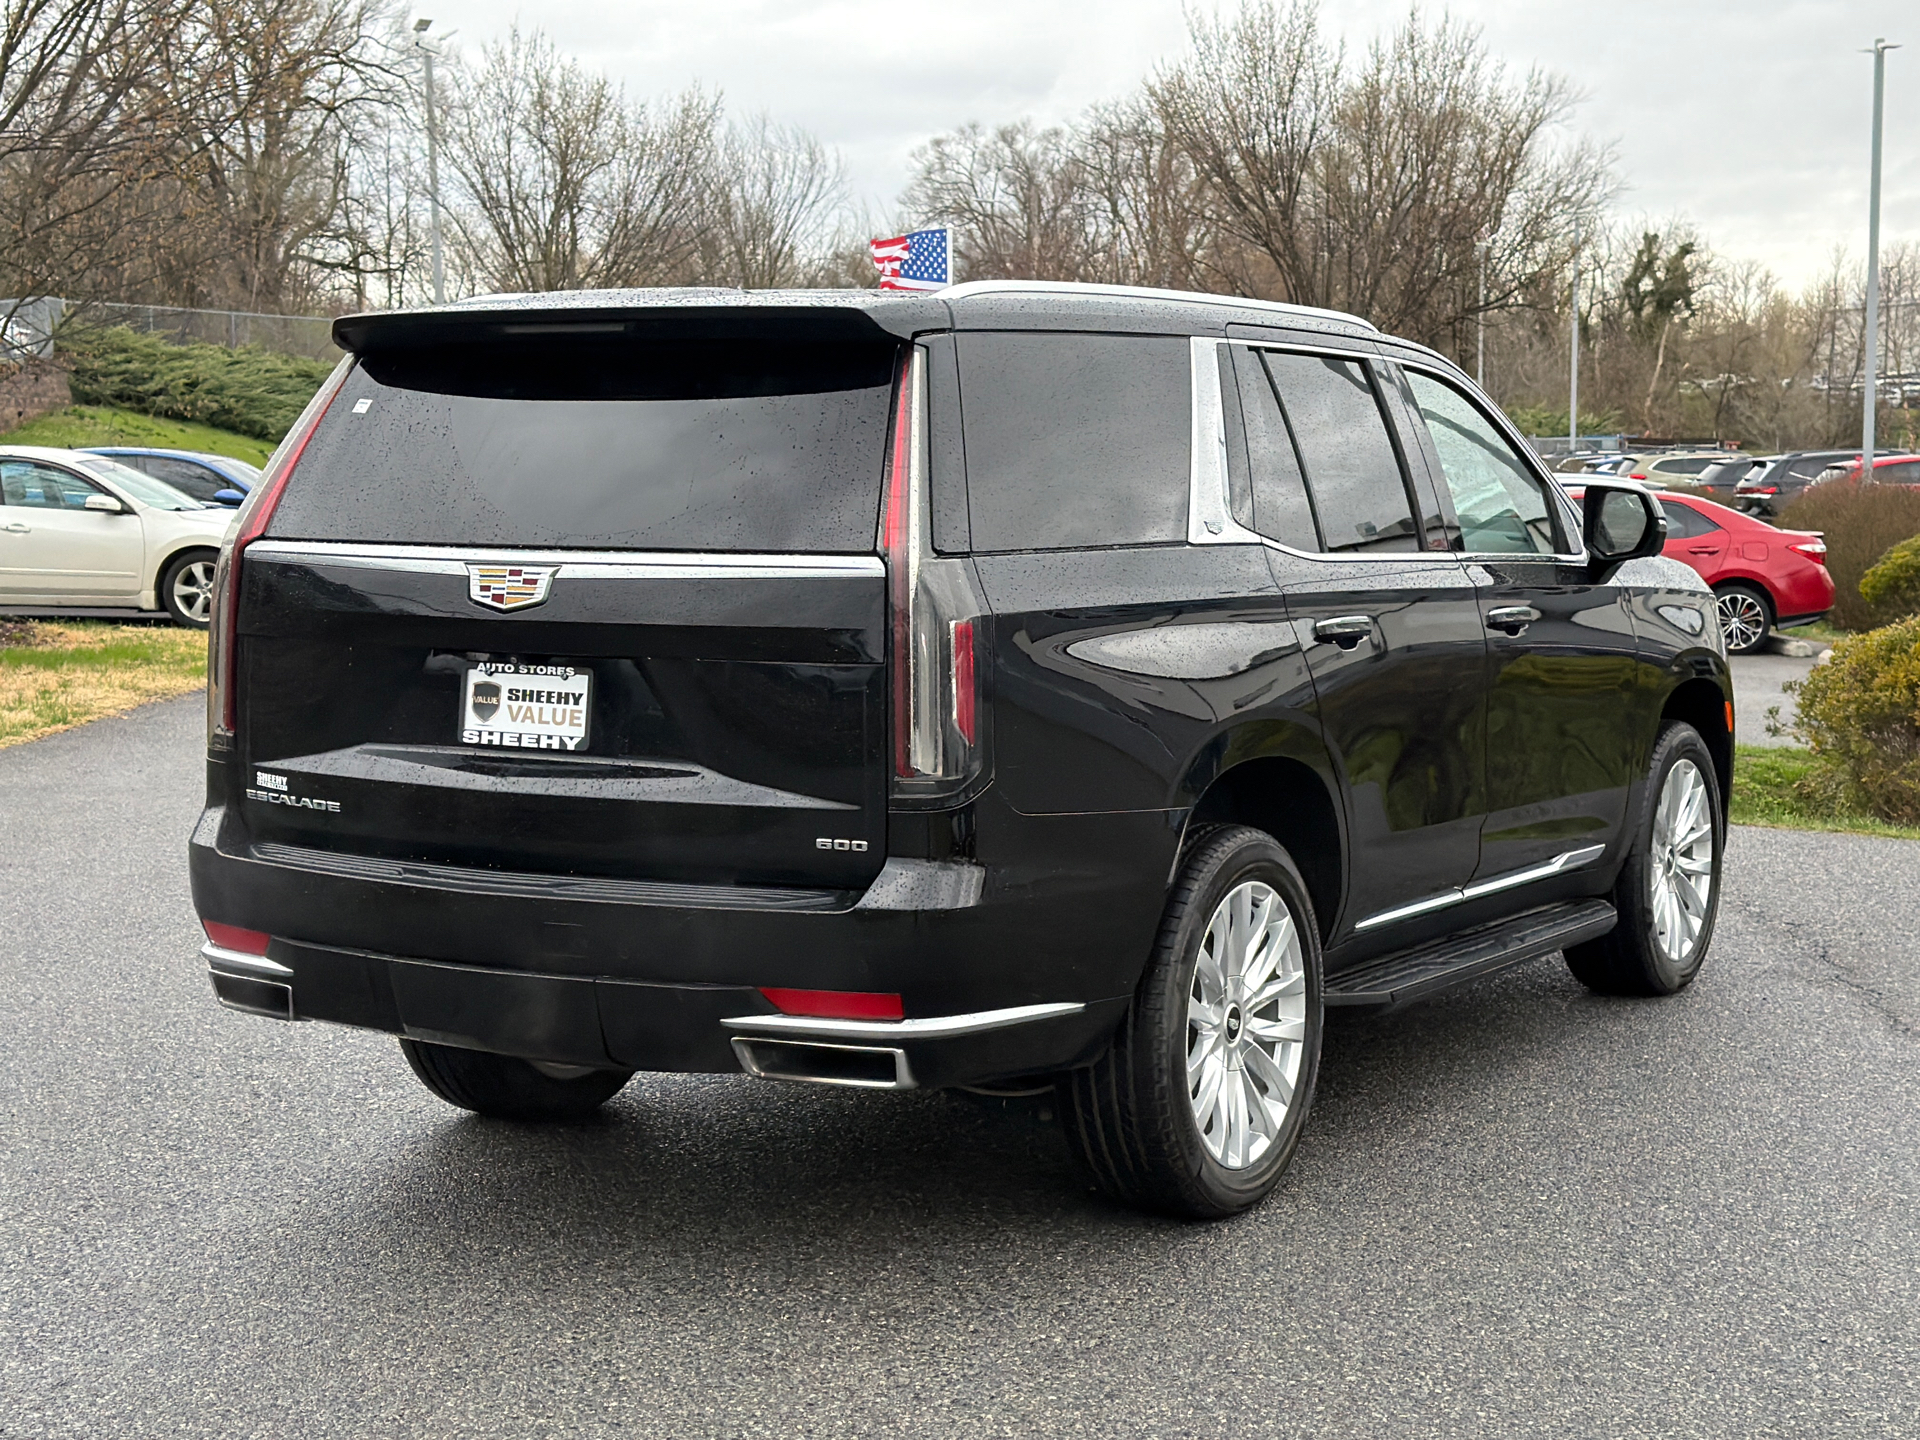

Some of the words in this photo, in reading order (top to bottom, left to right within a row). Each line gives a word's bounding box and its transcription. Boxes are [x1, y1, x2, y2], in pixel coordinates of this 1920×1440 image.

[477, 662, 514, 673] AUTO
[519, 665, 575, 676] STORES
[473, 695, 499, 705] VALUE
[507, 688, 584, 706] SHEEHY
[507, 704, 583, 727] VALUE
[462, 730, 582, 750] SHEEHY
[246, 789, 341, 812] ESCALADE
[816, 838, 868, 852] 600
